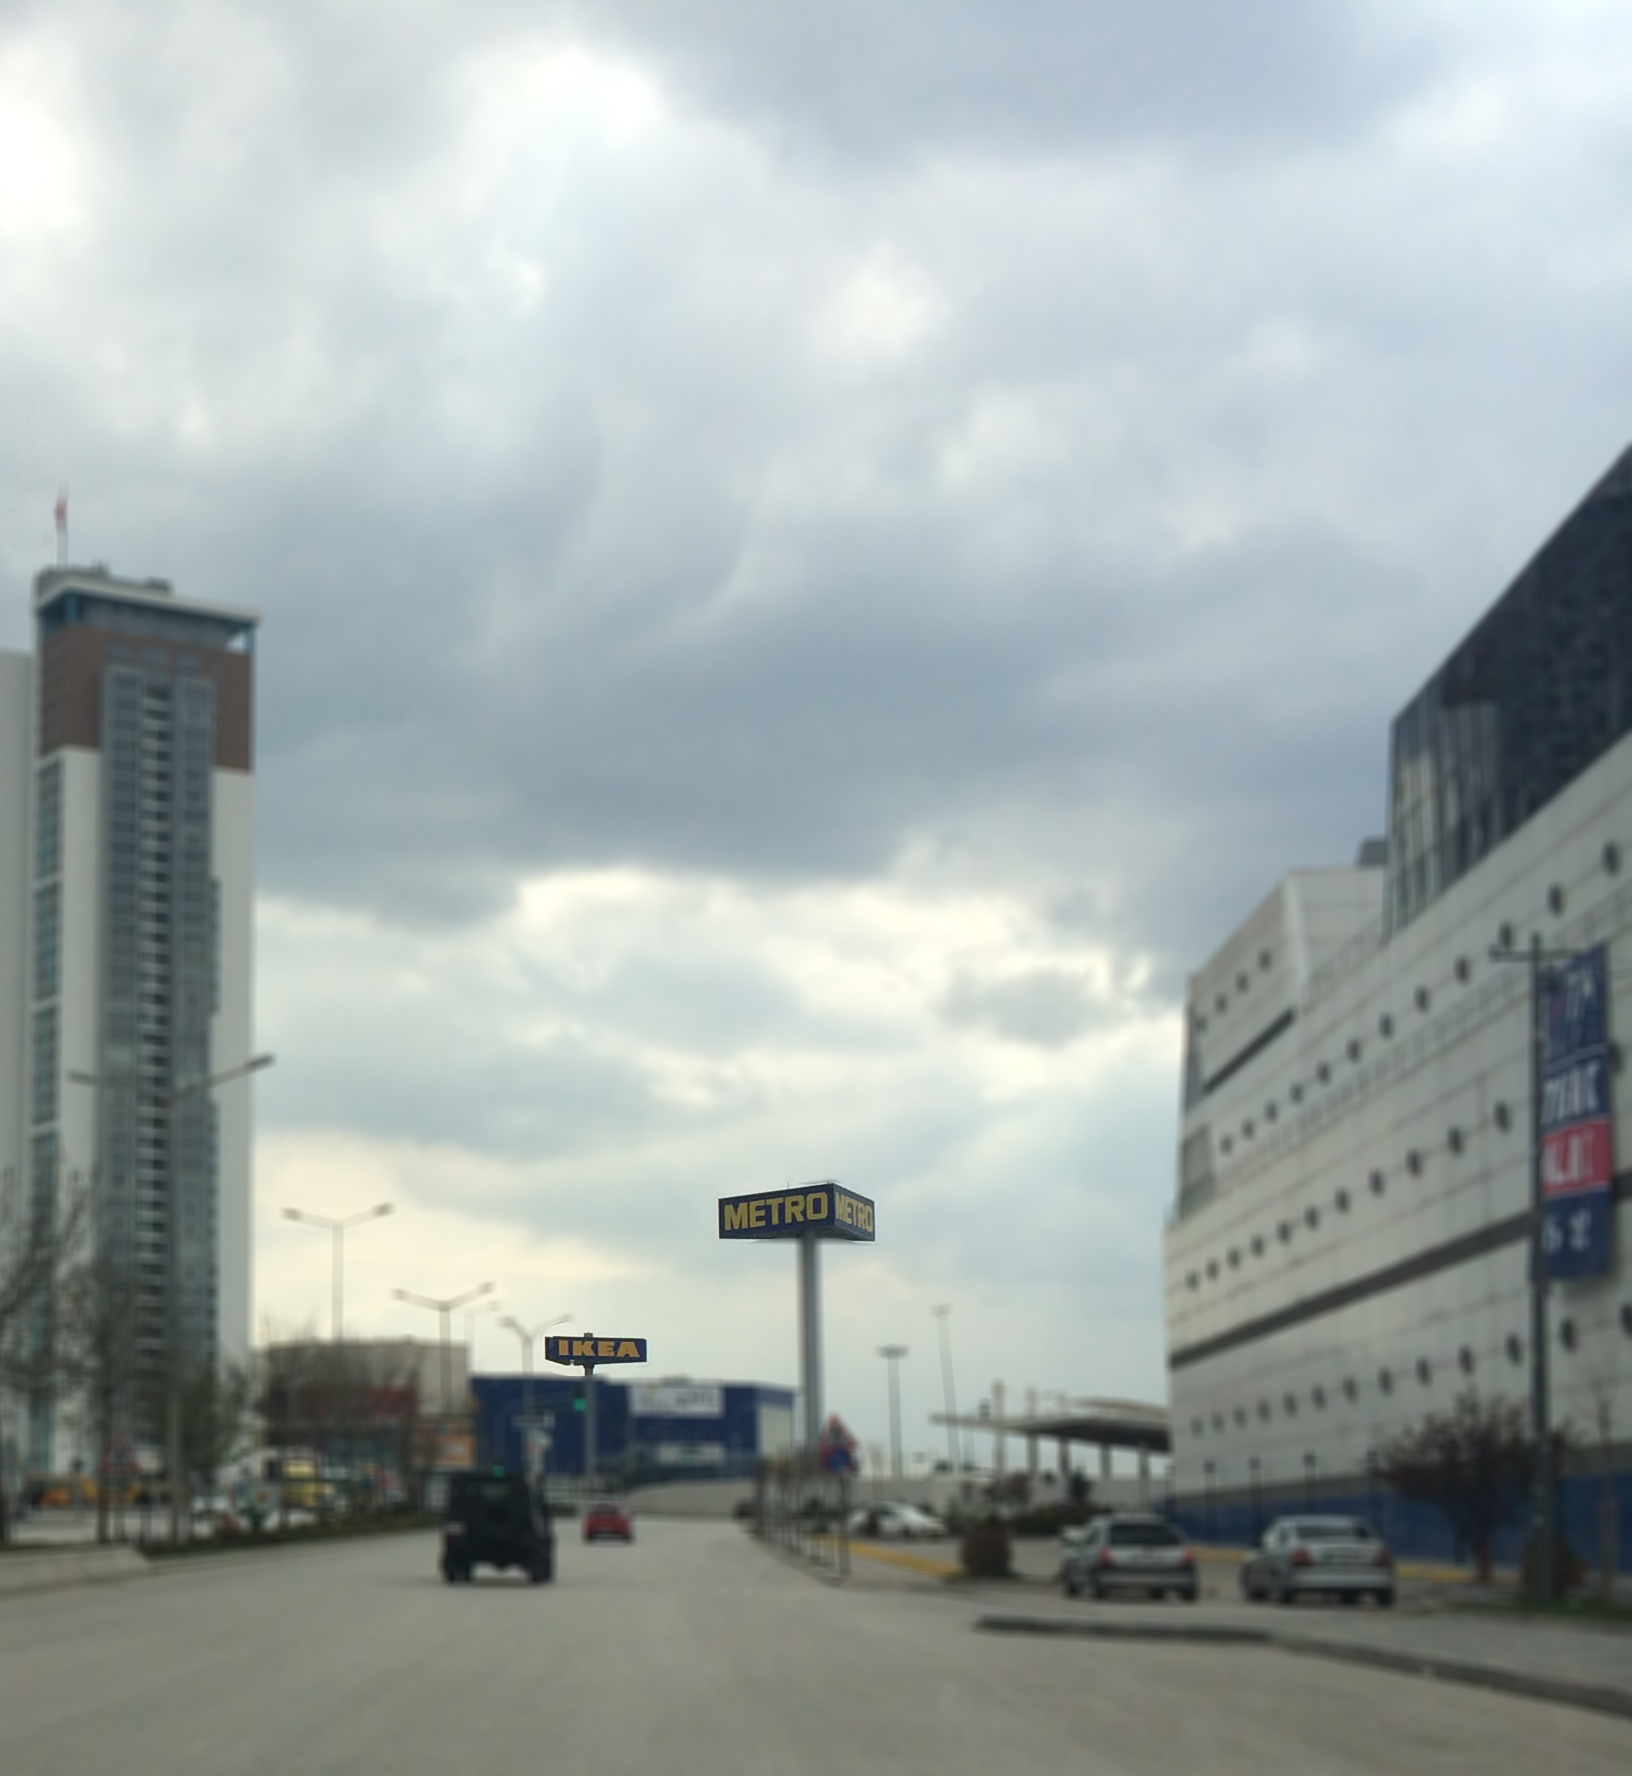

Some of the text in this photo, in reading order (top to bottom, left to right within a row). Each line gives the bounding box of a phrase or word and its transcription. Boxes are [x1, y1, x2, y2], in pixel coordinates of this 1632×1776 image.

[724, 1192, 828, 1231] METRO
[835, 1192, 874, 1233] METRO
[558, 1339, 640, 1358] IKEA
